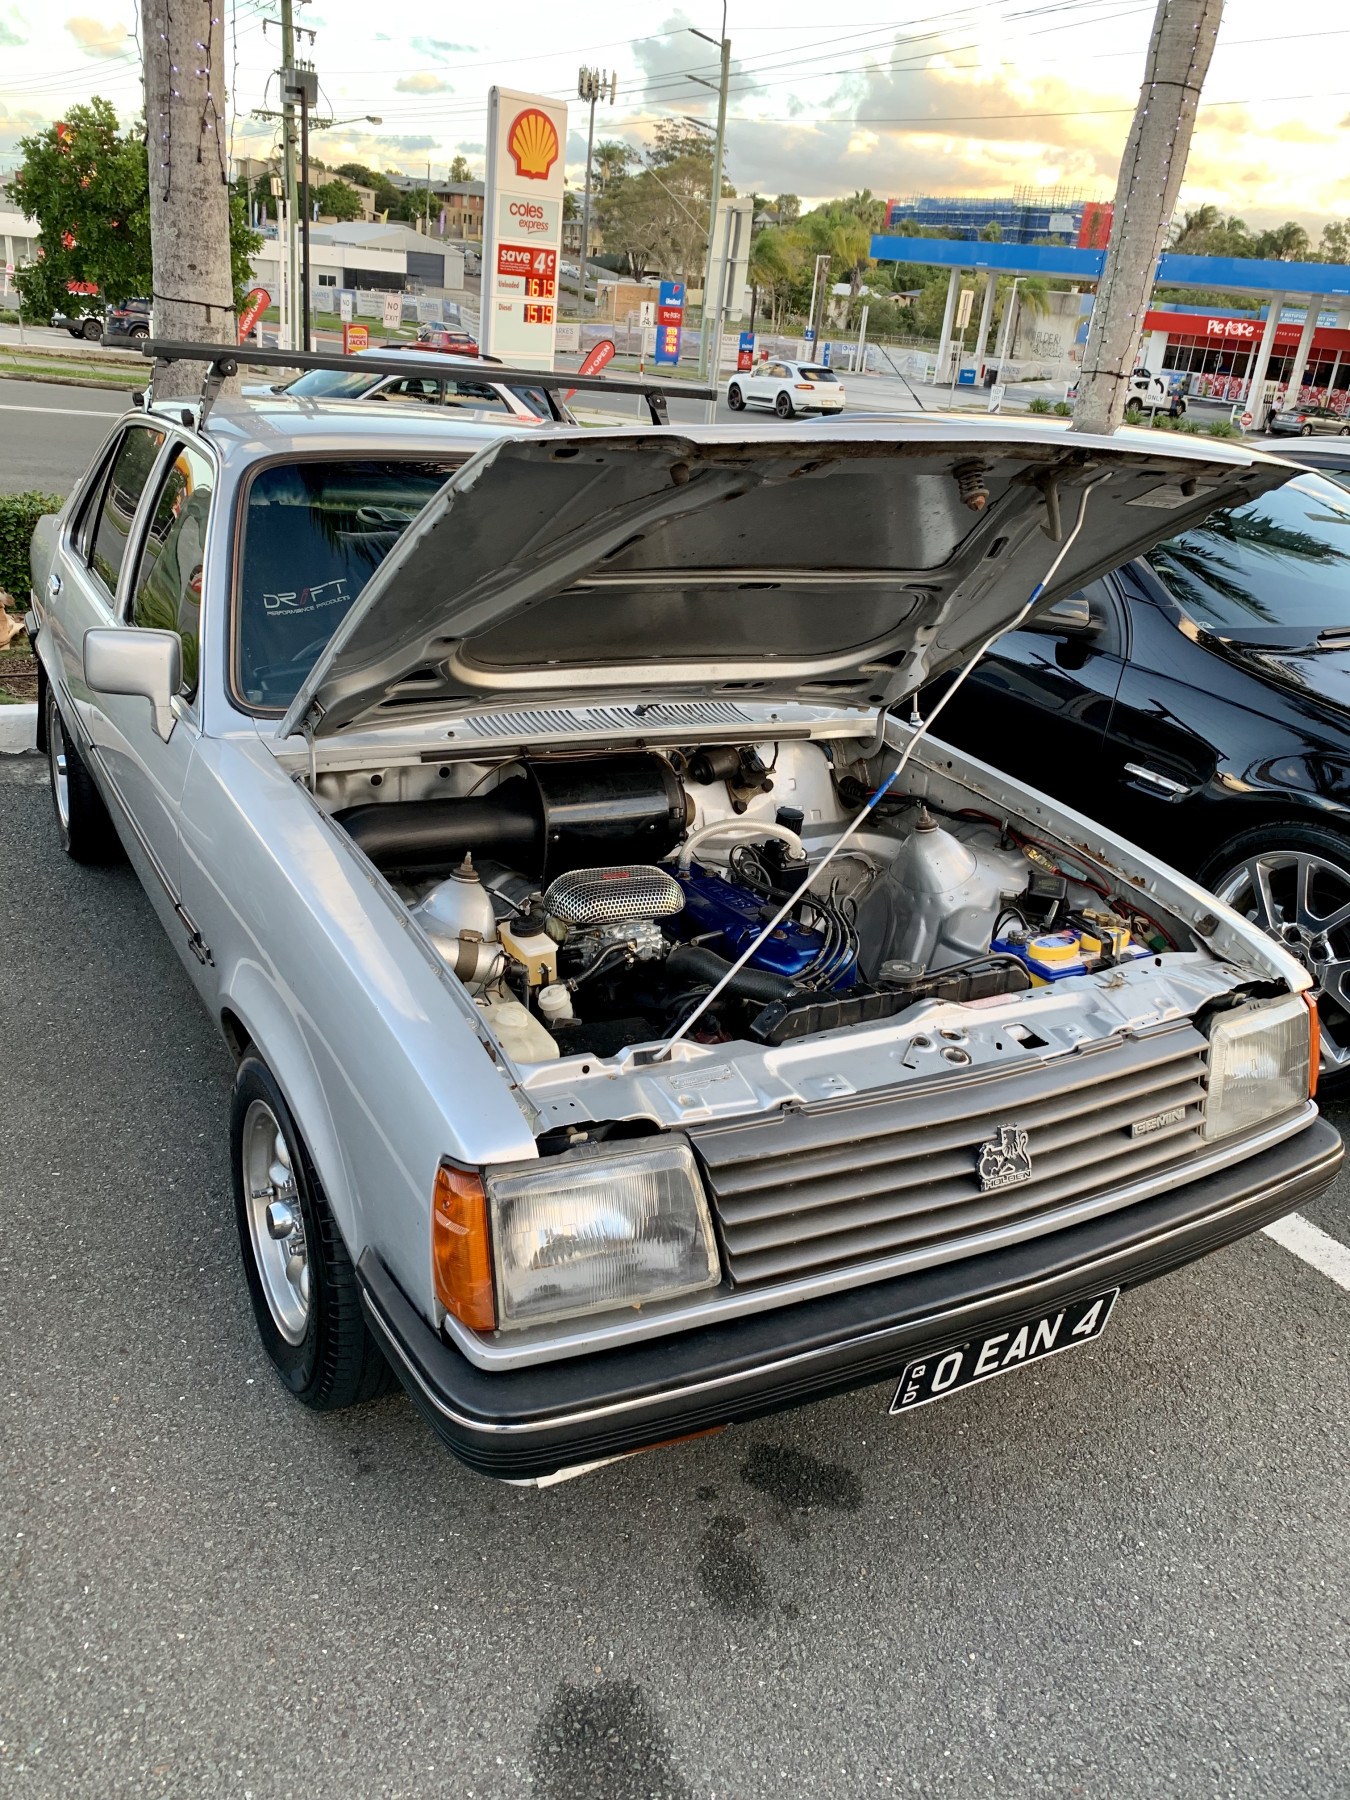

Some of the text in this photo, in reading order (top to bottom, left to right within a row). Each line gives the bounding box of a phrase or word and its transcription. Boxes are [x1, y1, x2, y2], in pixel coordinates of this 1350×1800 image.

[509, 202, 544, 219] coles
[518, 219, 549, 234] express
[500, 249, 531, 264] save
[498, 280, 520, 289] Unleaded
[342, 299, 350, 307] NO
[387, 302, 398, 310] NO
[498, 303, 512, 311] Diesel
[241, 310, 254, 331] NOW
[385, 314, 398, 322] EXIT
[1206, 319, 1254, 337] Pie face
[593, 344, 610, 367] OPEN
[1147, 394, 1164, 402] ONLY
[266, 595, 351, 616] PERFORMANCE PRODUCTS
[1135, 1107, 1185, 1136] GEMINI
[984, 1170, 1032, 1190] HOLDEN
[973, 1313, 1064, 1377] EAN
[1071, 1299, 1105, 1336] 4
